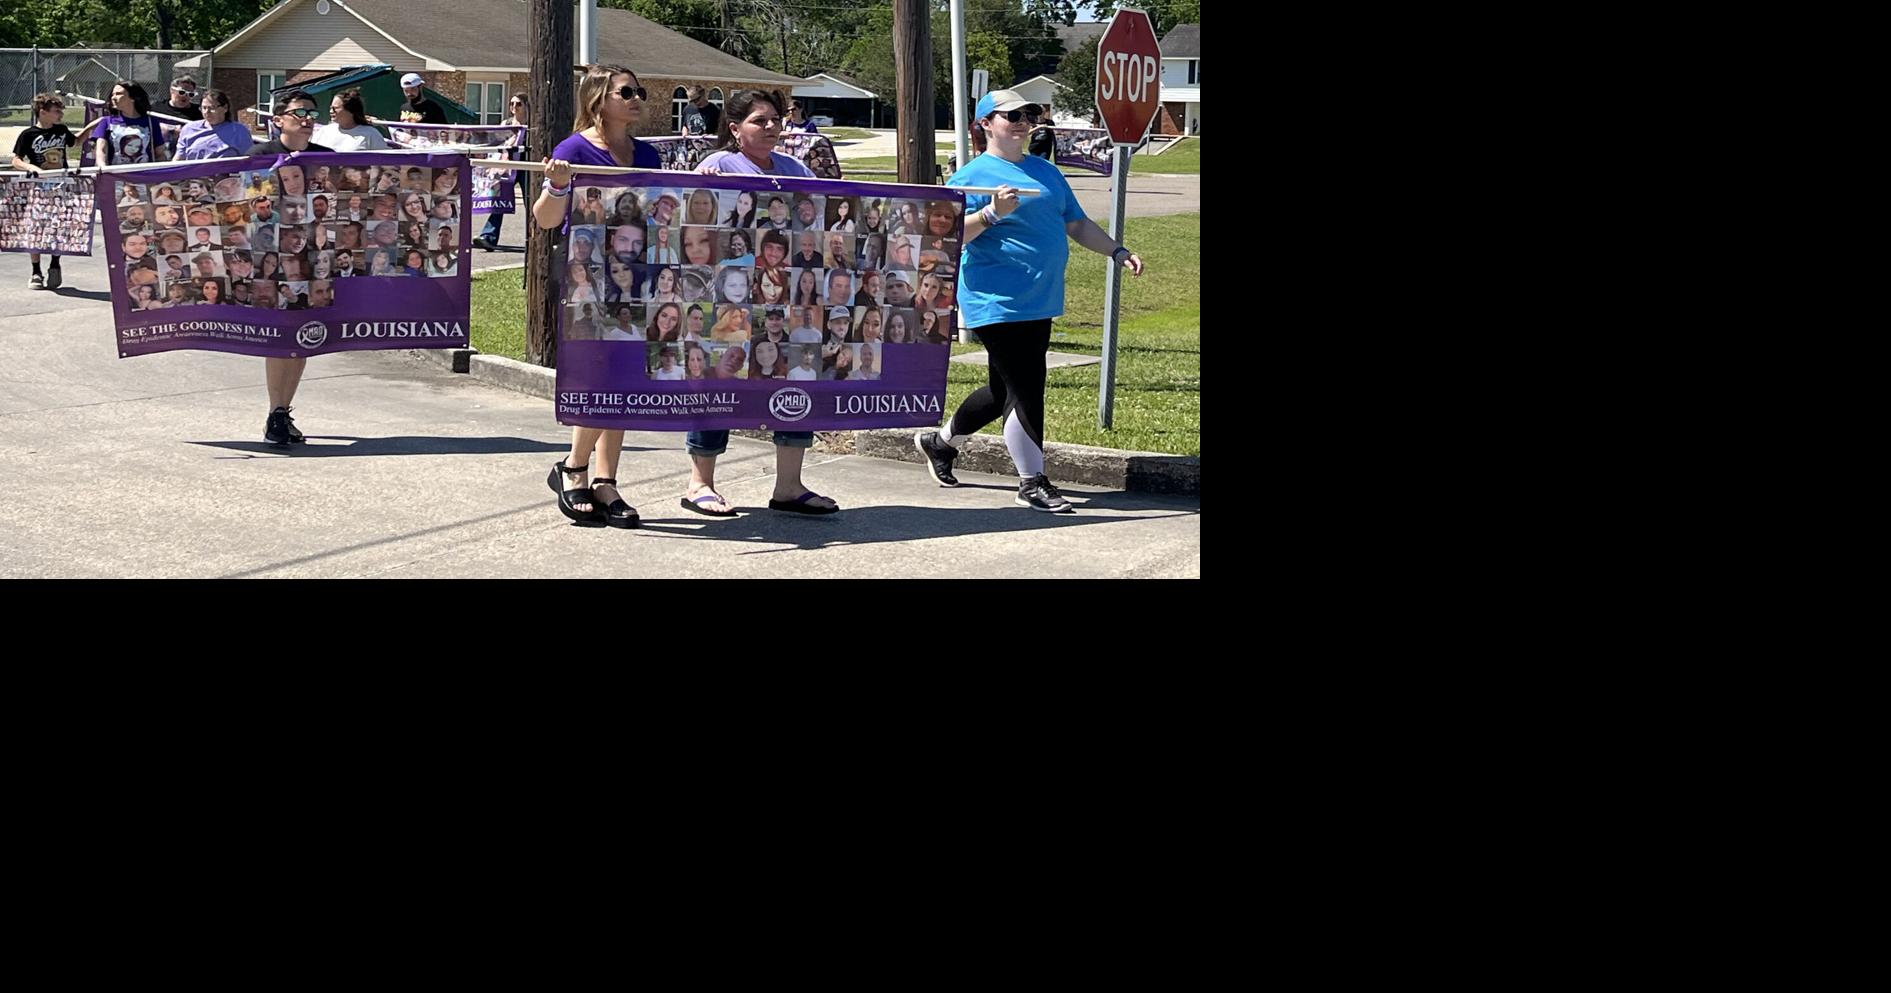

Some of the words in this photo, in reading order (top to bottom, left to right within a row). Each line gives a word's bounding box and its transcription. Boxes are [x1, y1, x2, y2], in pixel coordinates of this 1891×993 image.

[1101, 50, 1157, 103] STOP
[122, 327, 147, 339] SEE
[149, 323, 177, 335] THE
[179, 321, 242, 334] GOODNESS
[244, 325, 256, 335] IN
[258, 327, 281, 338] ALL
[341, 321, 464, 339] LOUISIANA
[560, 392, 589, 405] SEE
[592, 393, 623, 405] THE
[626, 393, 698, 406] GOODNESS
[699, 392, 710, 405] IN
[712, 392, 740, 404] ALL
[784, 394, 806, 407] MAD
[835, 394, 941, 414] LOUISIANA
[559, 404, 581, 415] Drug
[582, 405, 622, 415] Epidemic
[624, 406, 668, 415] Awareness
[670, 406, 689, 415] Walk
